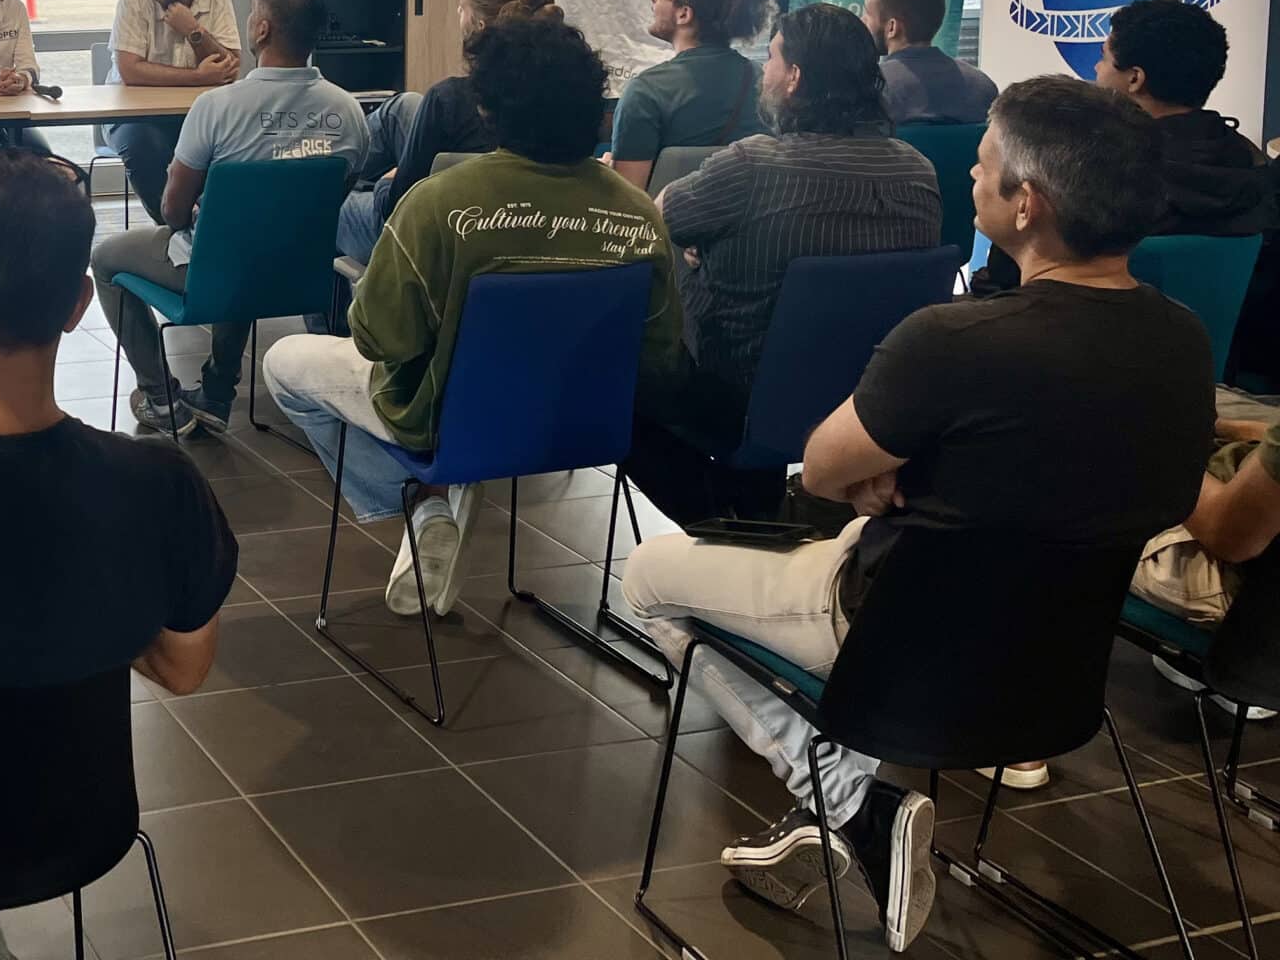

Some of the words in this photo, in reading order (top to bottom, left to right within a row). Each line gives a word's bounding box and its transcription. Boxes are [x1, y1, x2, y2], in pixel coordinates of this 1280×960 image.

[260, 111, 298, 129] BTS
[306, 111, 343, 130] SIO
[447, 206, 547, 241] Cultivate
[546, 215, 588, 240] your
[601, 240, 627, 259] stay
